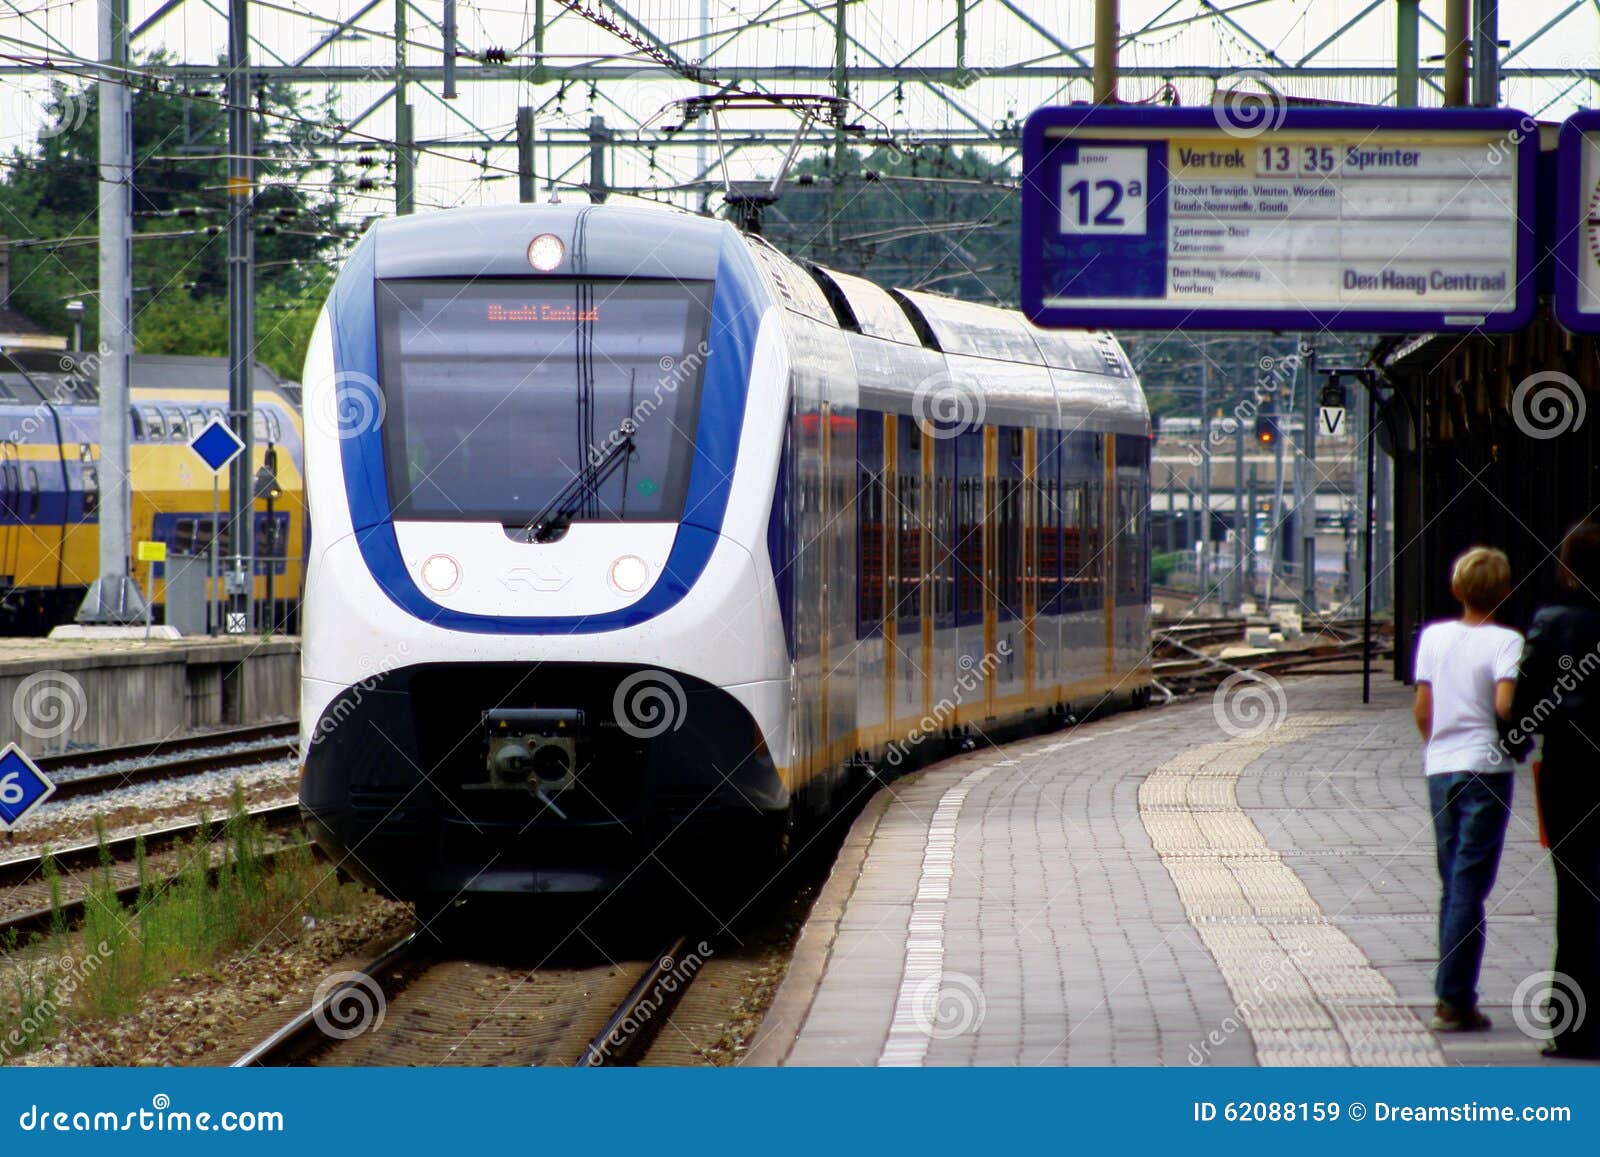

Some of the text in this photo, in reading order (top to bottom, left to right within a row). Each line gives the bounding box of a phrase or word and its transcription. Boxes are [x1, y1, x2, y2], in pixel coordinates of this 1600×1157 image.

[1179, 145, 1421, 171] Vertrek 13 35 Sprinter
[1173, 185, 1208, 197] Utrecht
[1293, 185, 1336, 197] Woerden
[1258, 201, 1289, 213] Gouda
[1172, 267, 1193, 278] Den
[1172, 283, 1214, 296] Voorburg
[1343, 270, 1507, 295] Den Haag Centraal
[1323, 409, 1343, 434] V
[0, 771, 24, 804] 6
